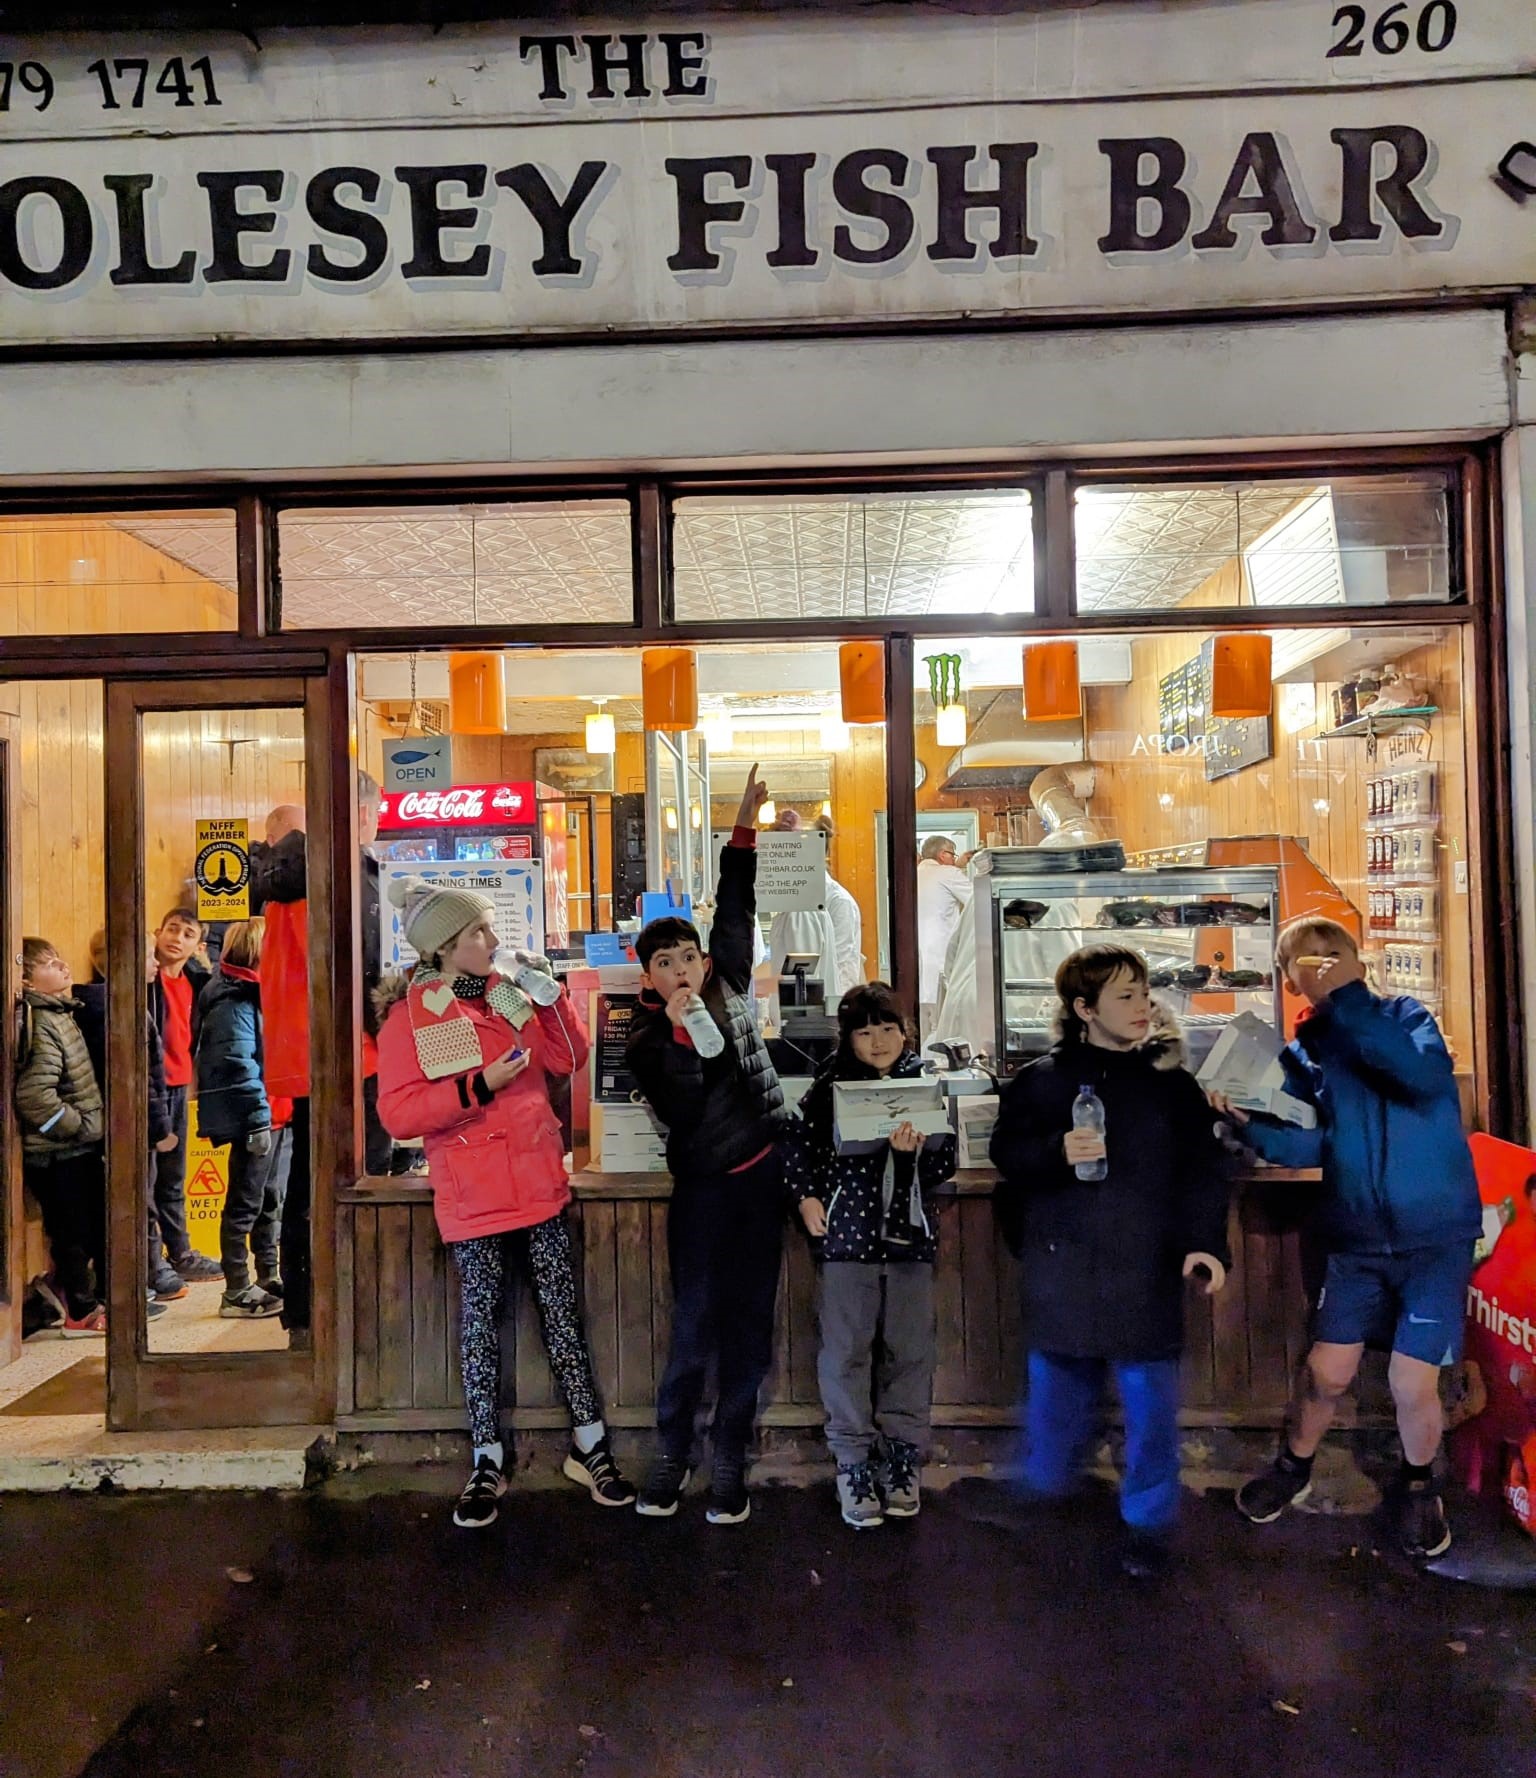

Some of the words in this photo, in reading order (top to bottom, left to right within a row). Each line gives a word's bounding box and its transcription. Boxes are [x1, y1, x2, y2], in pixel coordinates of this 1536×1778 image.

[1325, 0, 1458, 59] 260
[518, 32, 710, 102] THE
[86, 56, 223, 111] 1741
[665, 139, 1040, 273] FISH
[1096, 124, 1445, 254] BAR
[1387, 732, 1426, 763] HEINZ
[395, 767, 436, 780] OPEN
[398, 789, 486, 822] Coca-Cola
[209, 821, 235, 831] NFFF
[199, 830, 245, 840] MEMBER
[424, 878, 466, 887] PENING
[469, 877, 502, 887] TIMES
[556, 962, 571, 970] STAFF
[190, 1149, 225, 1157] CAUTION
[190, 1198, 220, 1209] WET
[184, 1209, 219, 1220] LOO
